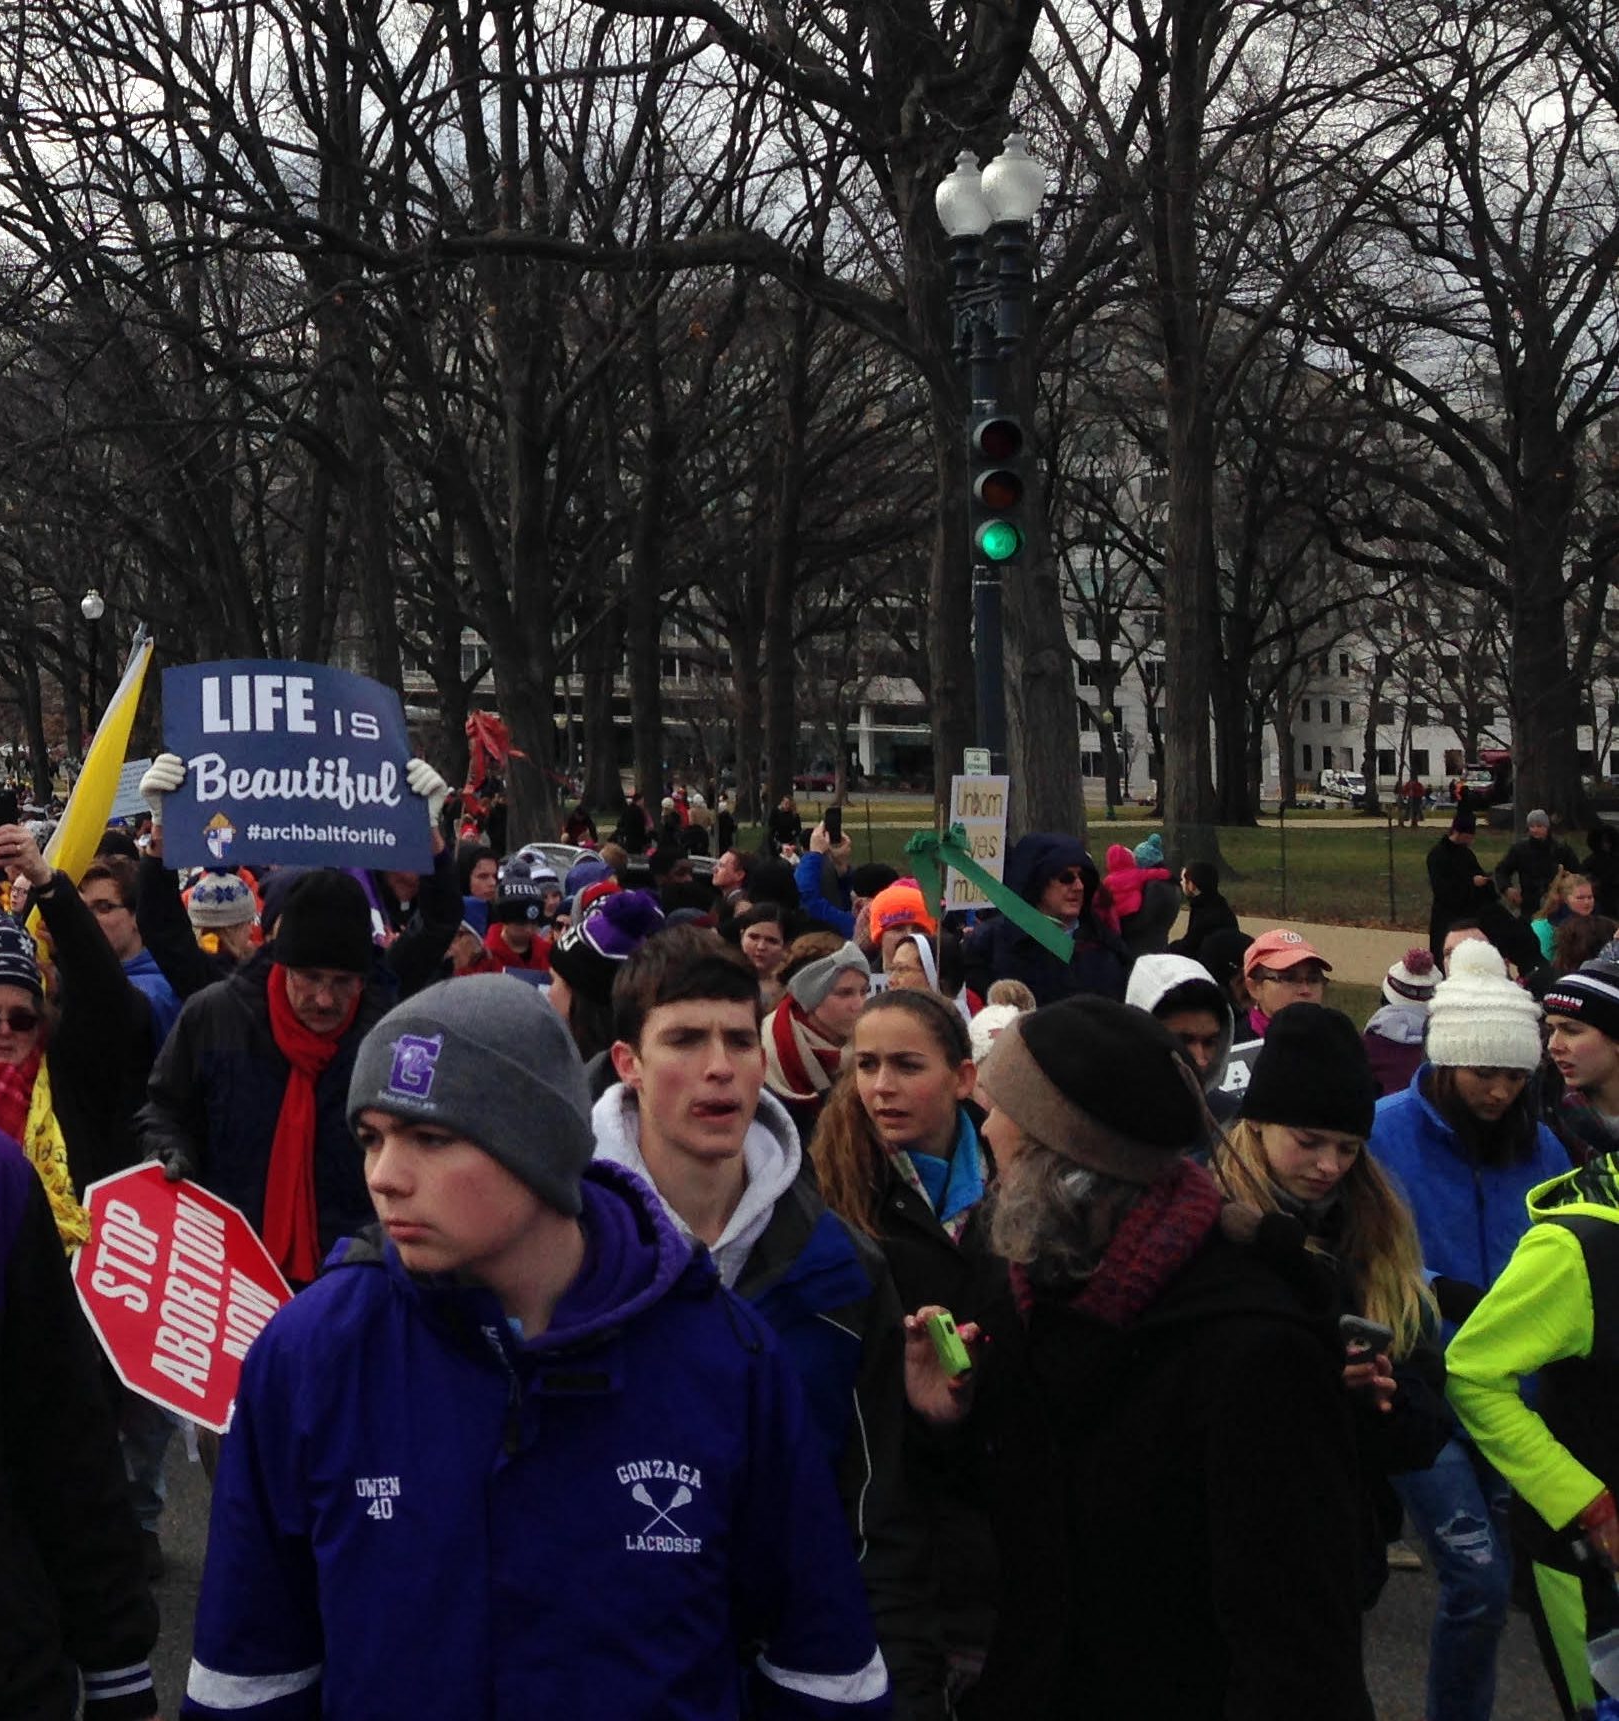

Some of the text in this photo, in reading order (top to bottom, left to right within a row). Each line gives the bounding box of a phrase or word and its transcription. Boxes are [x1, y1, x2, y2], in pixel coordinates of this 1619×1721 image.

[202, 675, 380, 741] LIFE IS
[187, 752, 401, 810] Beautiful
[246, 823, 397, 847] #archbaltforlife
[91, 1199, 160, 1314] STOP
[150, 1191, 226, 1399] ABORTION
[222, 1267, 280, 1362] NOW
[355, 1476, 401, 1498] OWEN
[616, 1459, 703, 1490] GONZAGA
[366, 1498, 393, 1520] 40
[625, 1534, 702, 1554] LACROSSE
